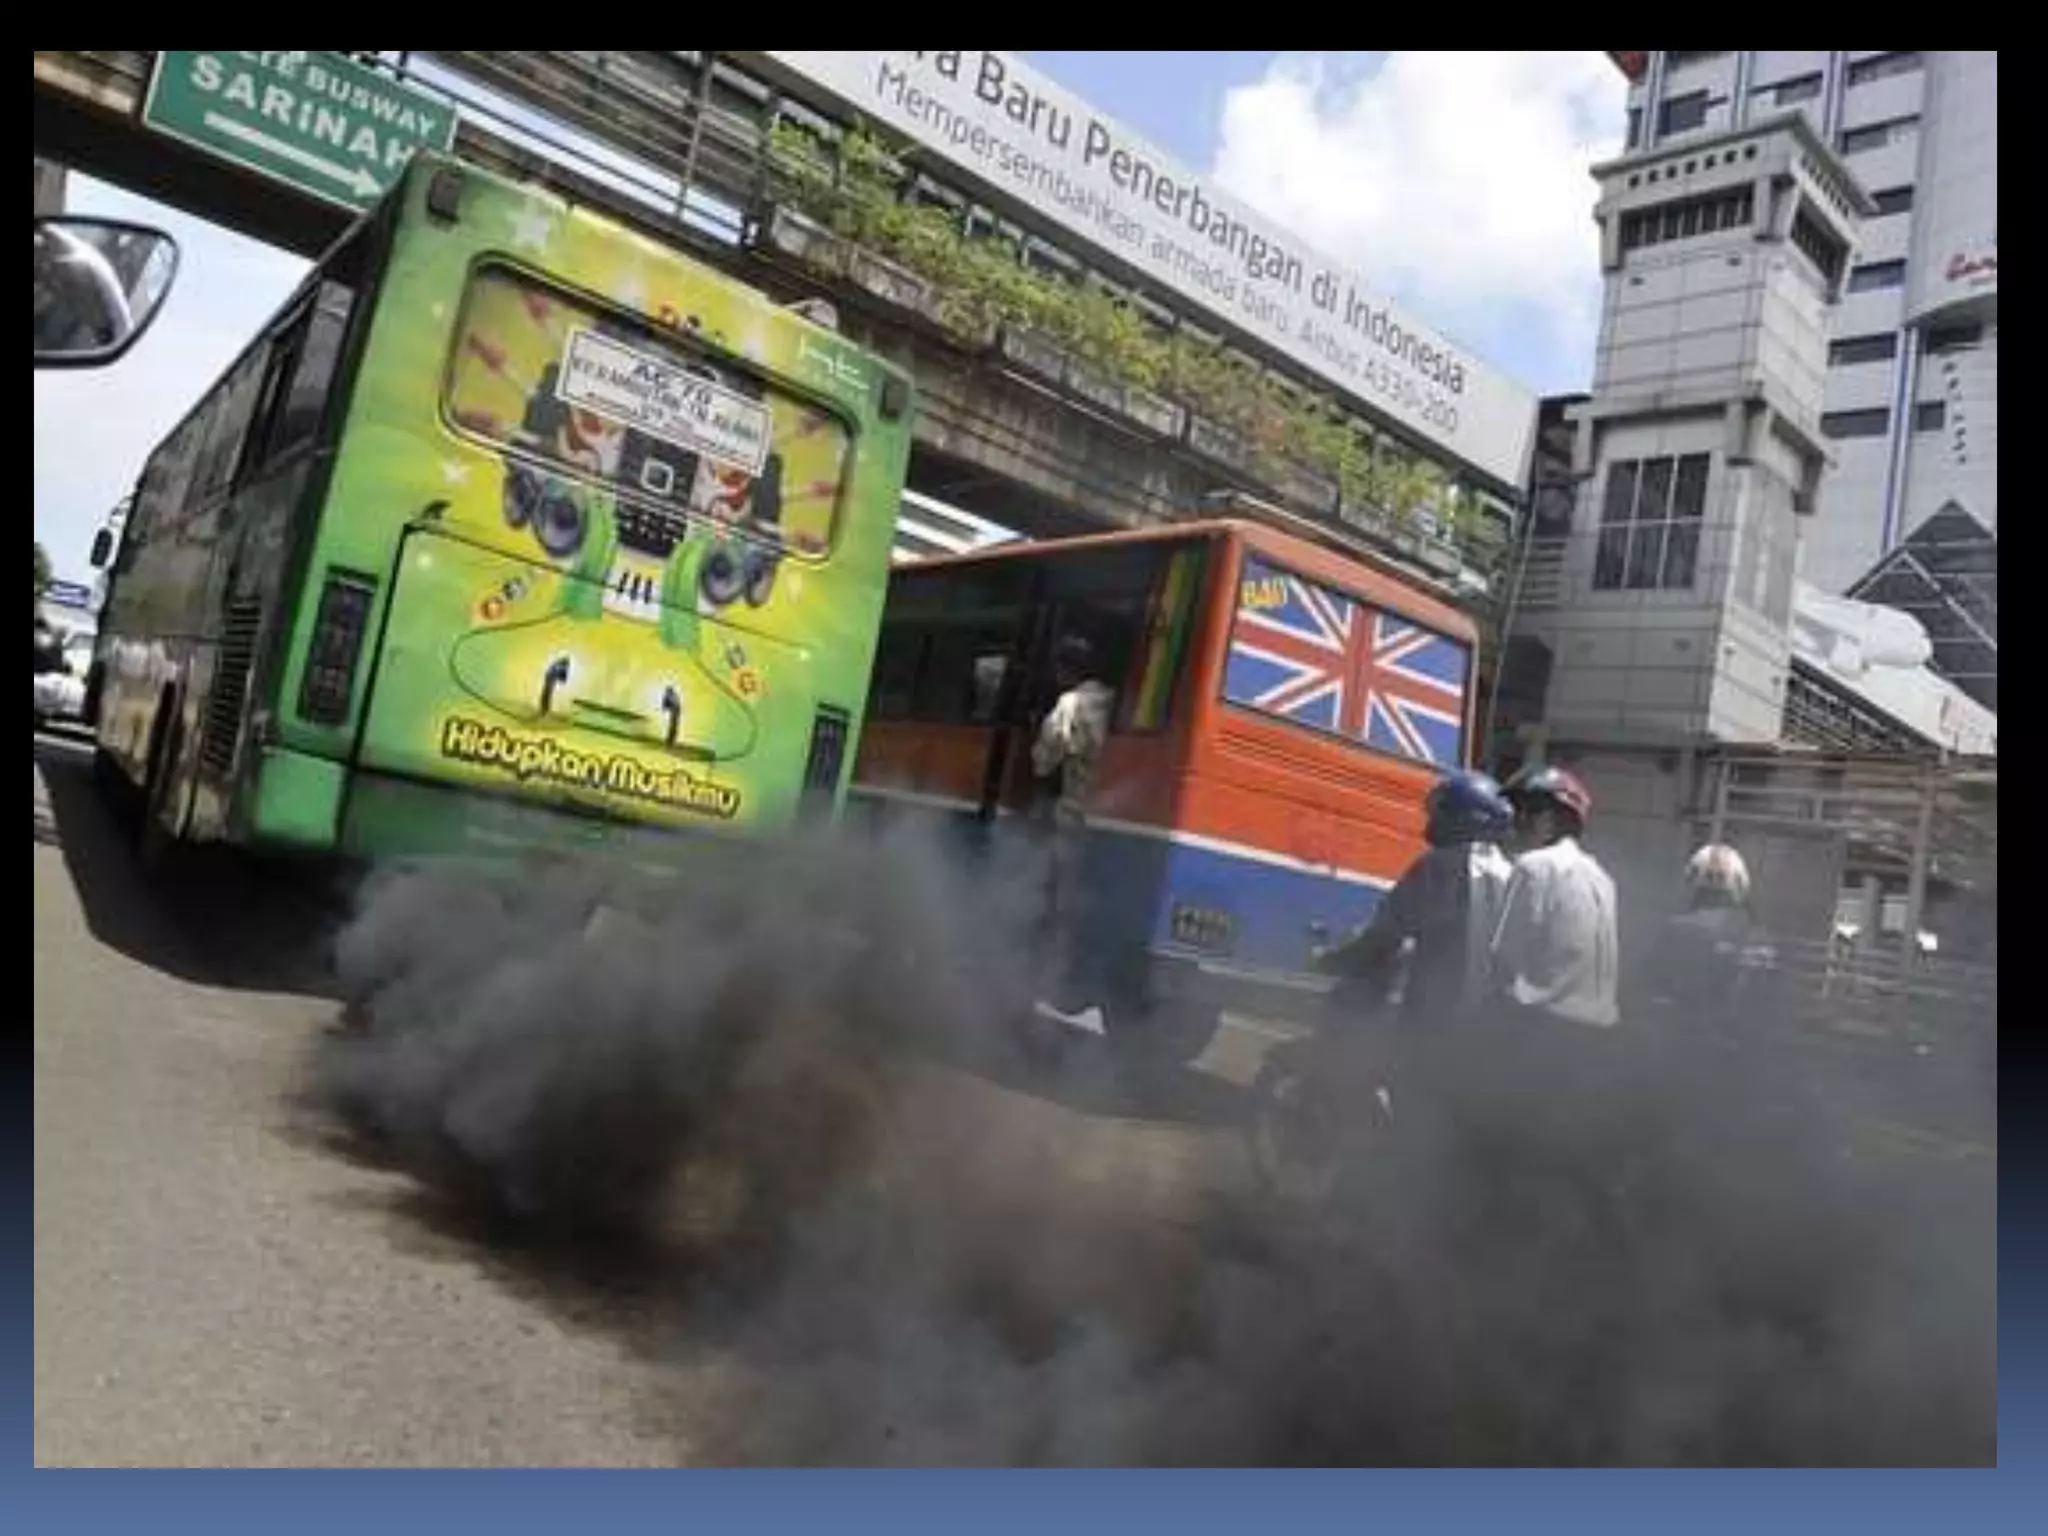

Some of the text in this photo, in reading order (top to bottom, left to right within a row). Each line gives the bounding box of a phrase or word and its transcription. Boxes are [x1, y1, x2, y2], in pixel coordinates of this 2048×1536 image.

[190, 53, 416, 169] SARINAH
[305, 65, 435, 137] BUSWAY
[974, 51, 1072, 150] Baru
[1083, 119, 1303, 294] Penerbangan
[1311, 269, 1339, 314] di
[1344, 286, 1464, 394] Indonesia
[443, 717, 741, 818] Hidupkan Musikmu
